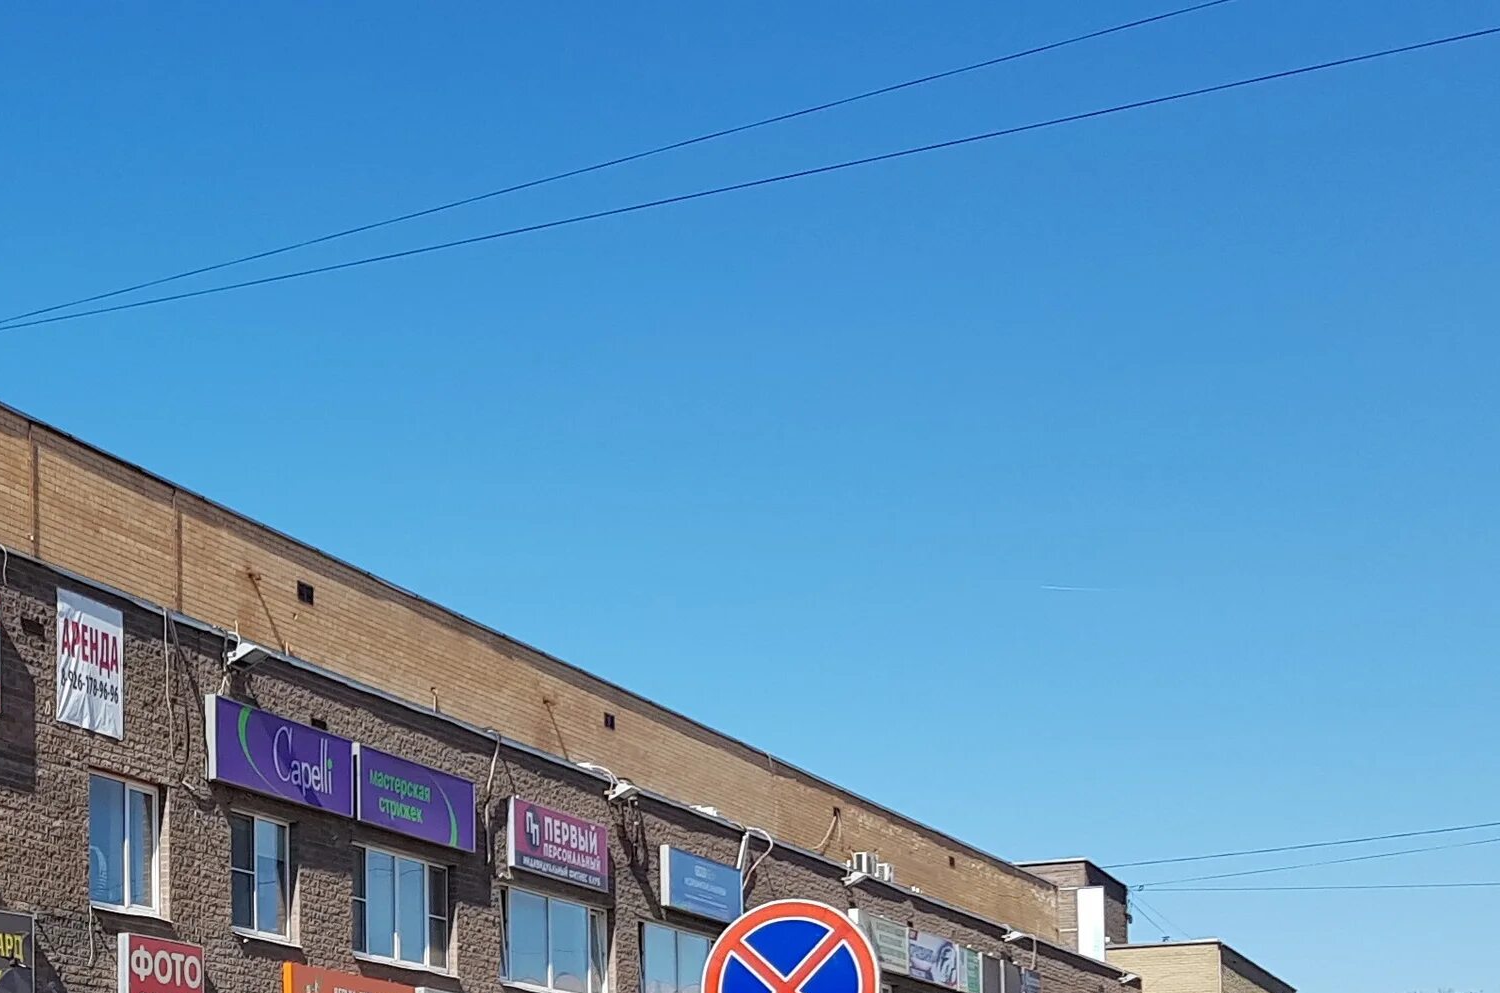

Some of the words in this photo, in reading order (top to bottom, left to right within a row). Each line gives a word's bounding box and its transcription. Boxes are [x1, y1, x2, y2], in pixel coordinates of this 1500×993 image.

[61, 617, 119, 675] АРЕНДА
[273, 725, 334, 796] Capelli
[369, 768, 431, 801] мастерская
[378, 795, 424, 824] стрижек
[543, 816, 598, 855] ПЕРВЫЙ
[130, 945, 202, 989] ФОТО
